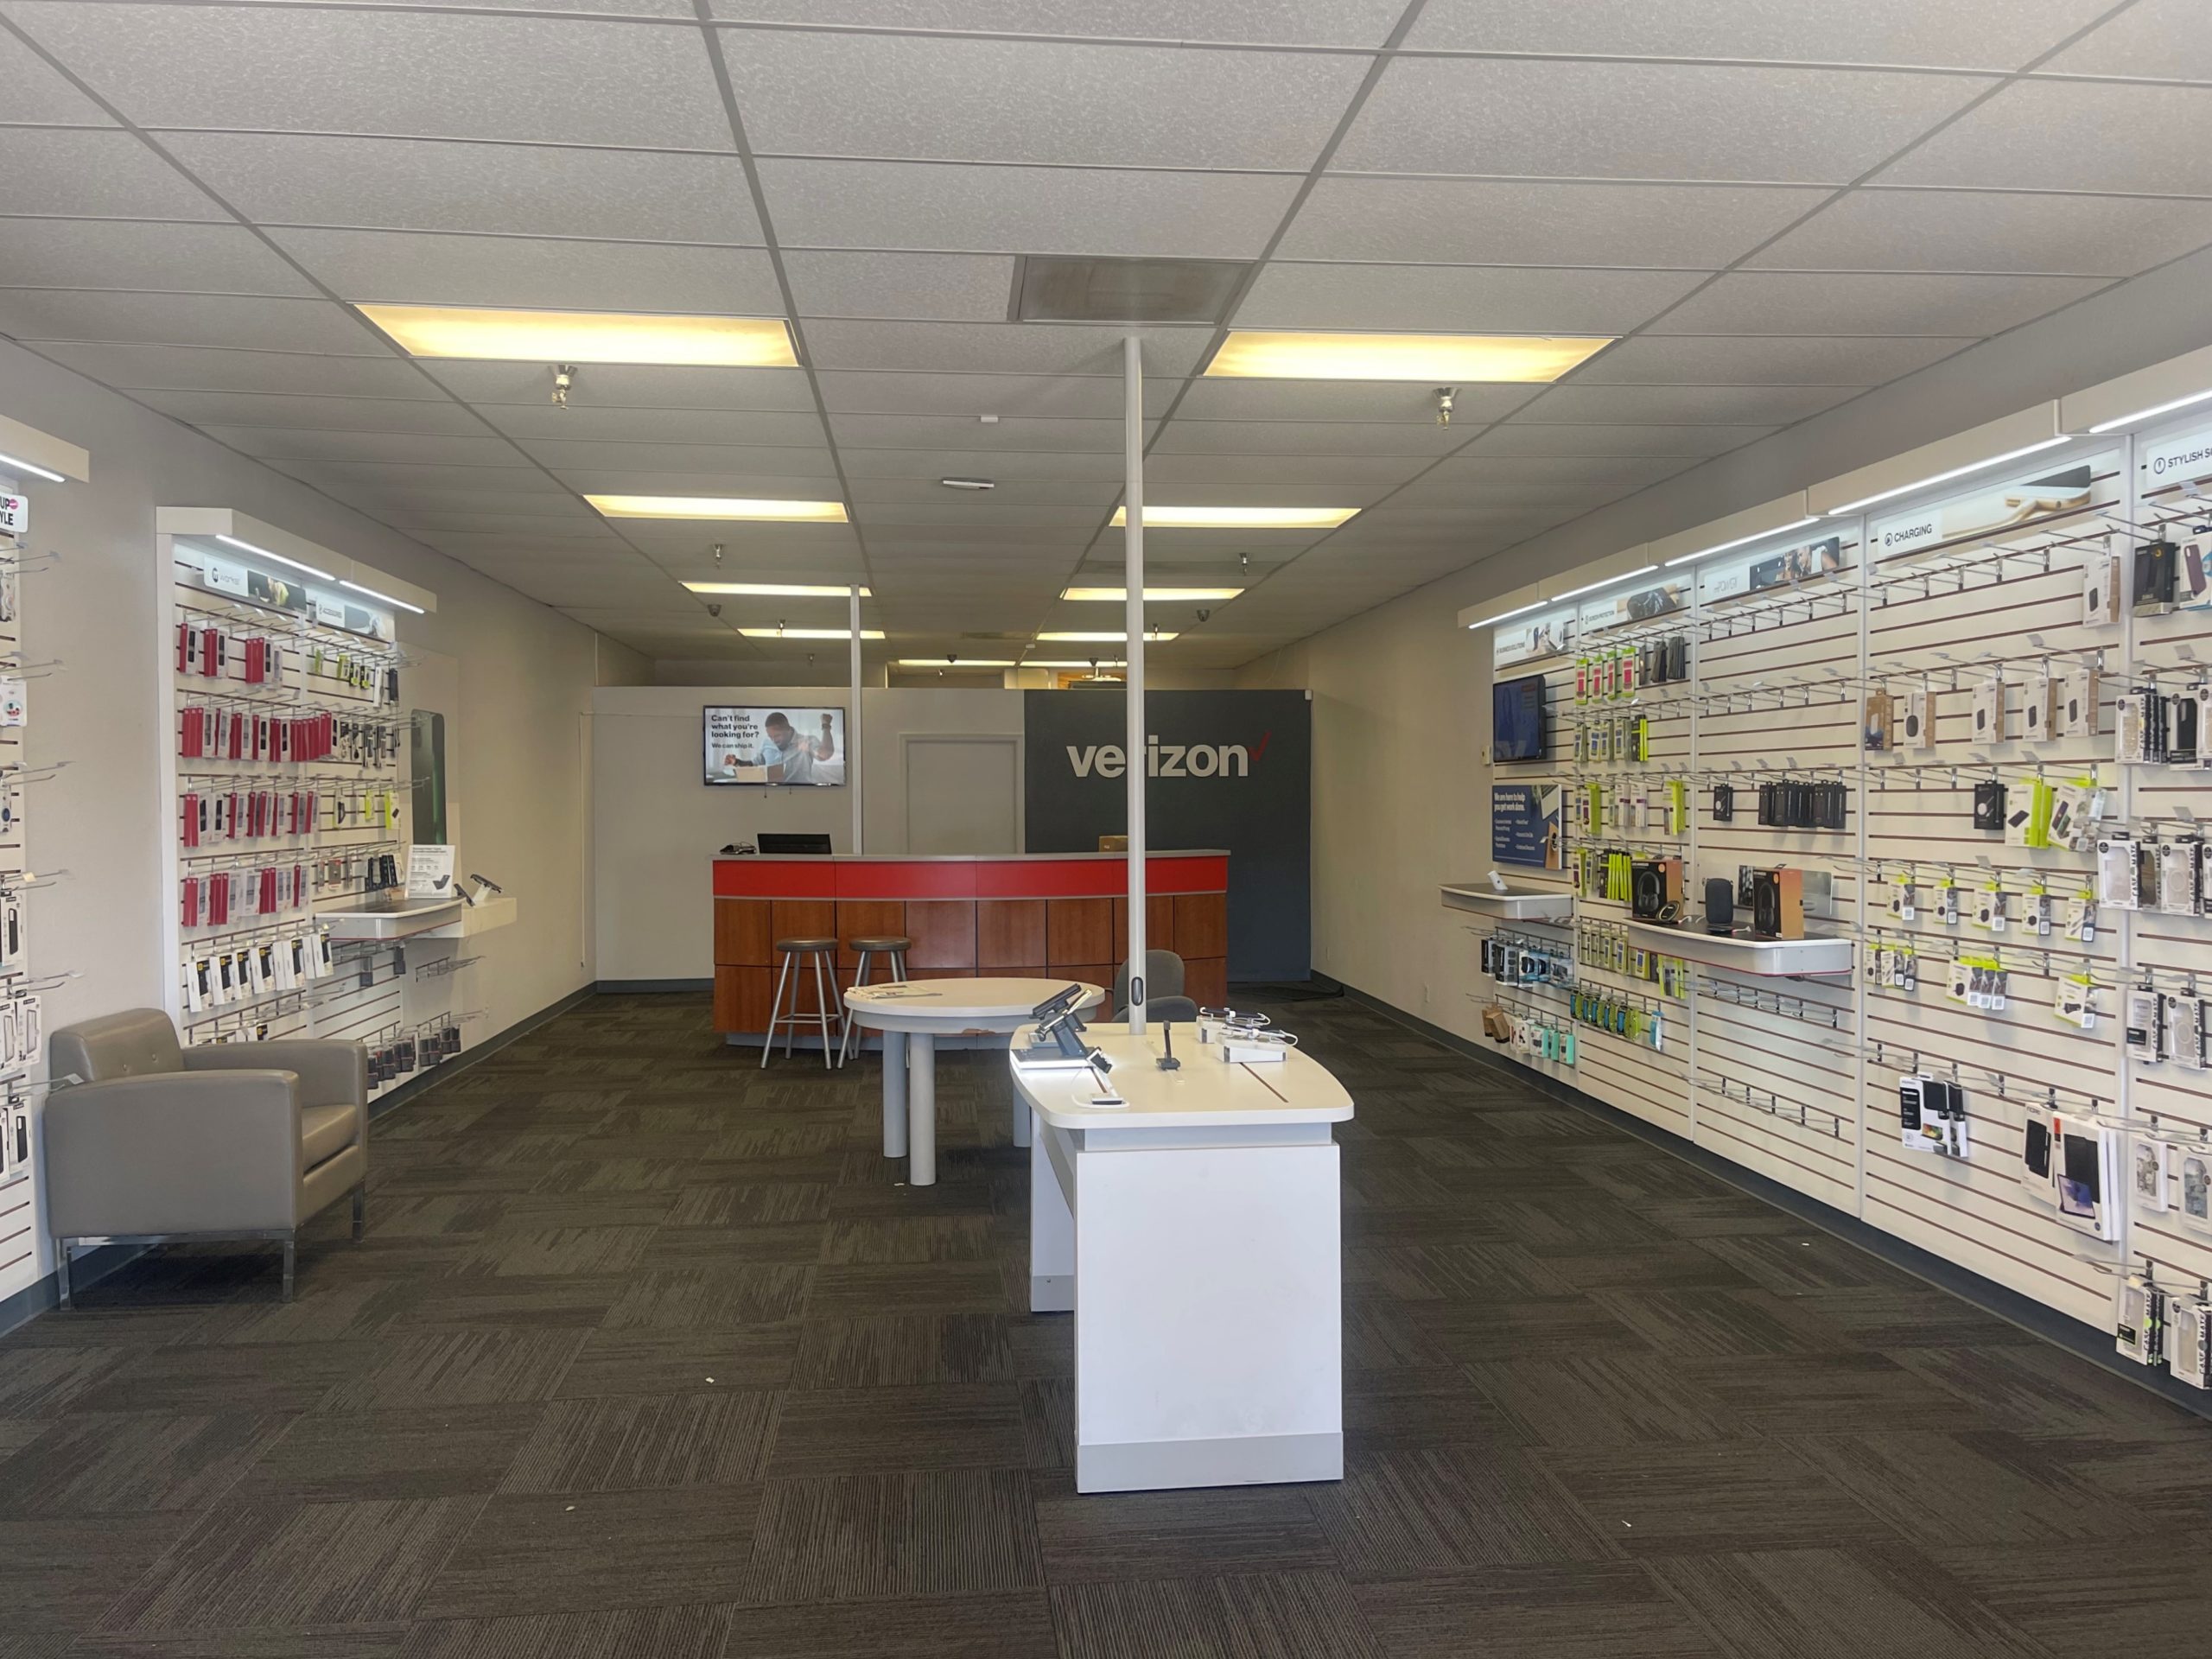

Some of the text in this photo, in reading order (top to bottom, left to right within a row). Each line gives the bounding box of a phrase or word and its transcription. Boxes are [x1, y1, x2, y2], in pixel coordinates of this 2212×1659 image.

[2168, 449, 2203, 467] STYLISH
[1894, 524, 1932, 542] CHARGING
[1066, 734, 1249, 778] veizon
